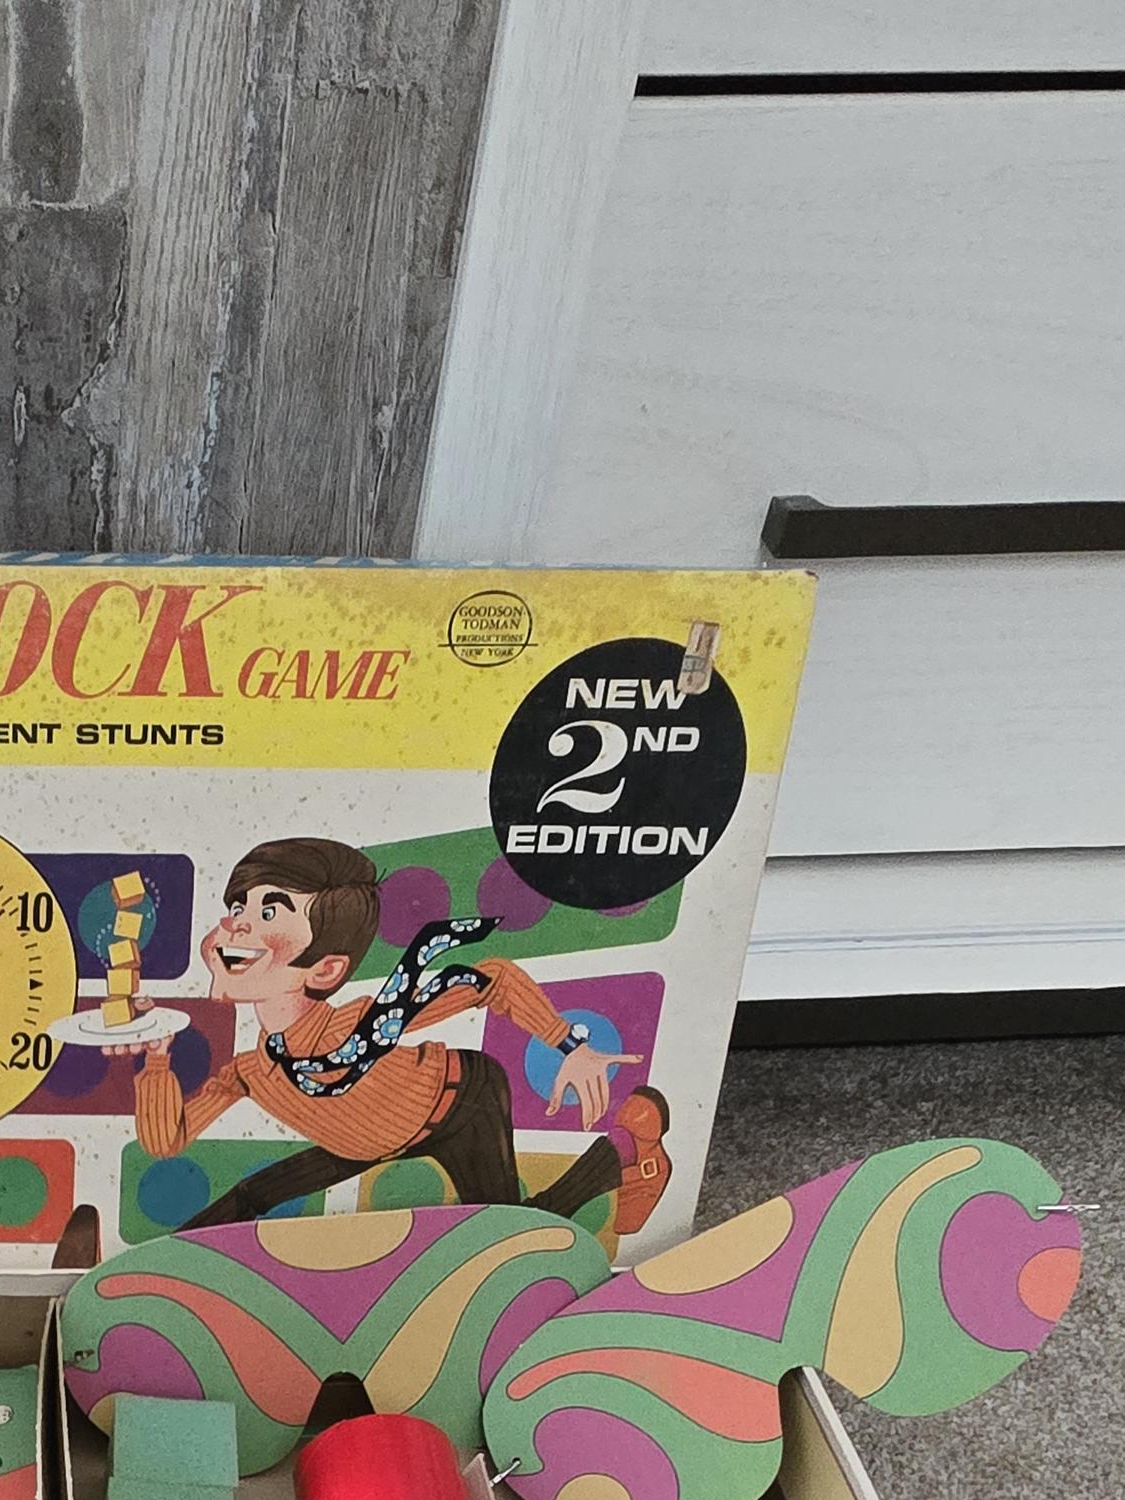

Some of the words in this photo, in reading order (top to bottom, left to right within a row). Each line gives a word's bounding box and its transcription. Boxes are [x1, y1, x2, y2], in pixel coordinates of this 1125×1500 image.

[459, 606, 523, 617] GOODSON
[462, 619, 520, 630] TODMAN
[461, 648, 485, 657] NEW
[238, 647, 411, 700] GAME
[565, 679, 687, 709] NEW
[76, 723, 225, 745] STUNTS
[506, 825, 709, 855] EDITION
[16, 893, 53, 933] 10
[10, 1032, 53, 1070] 20
